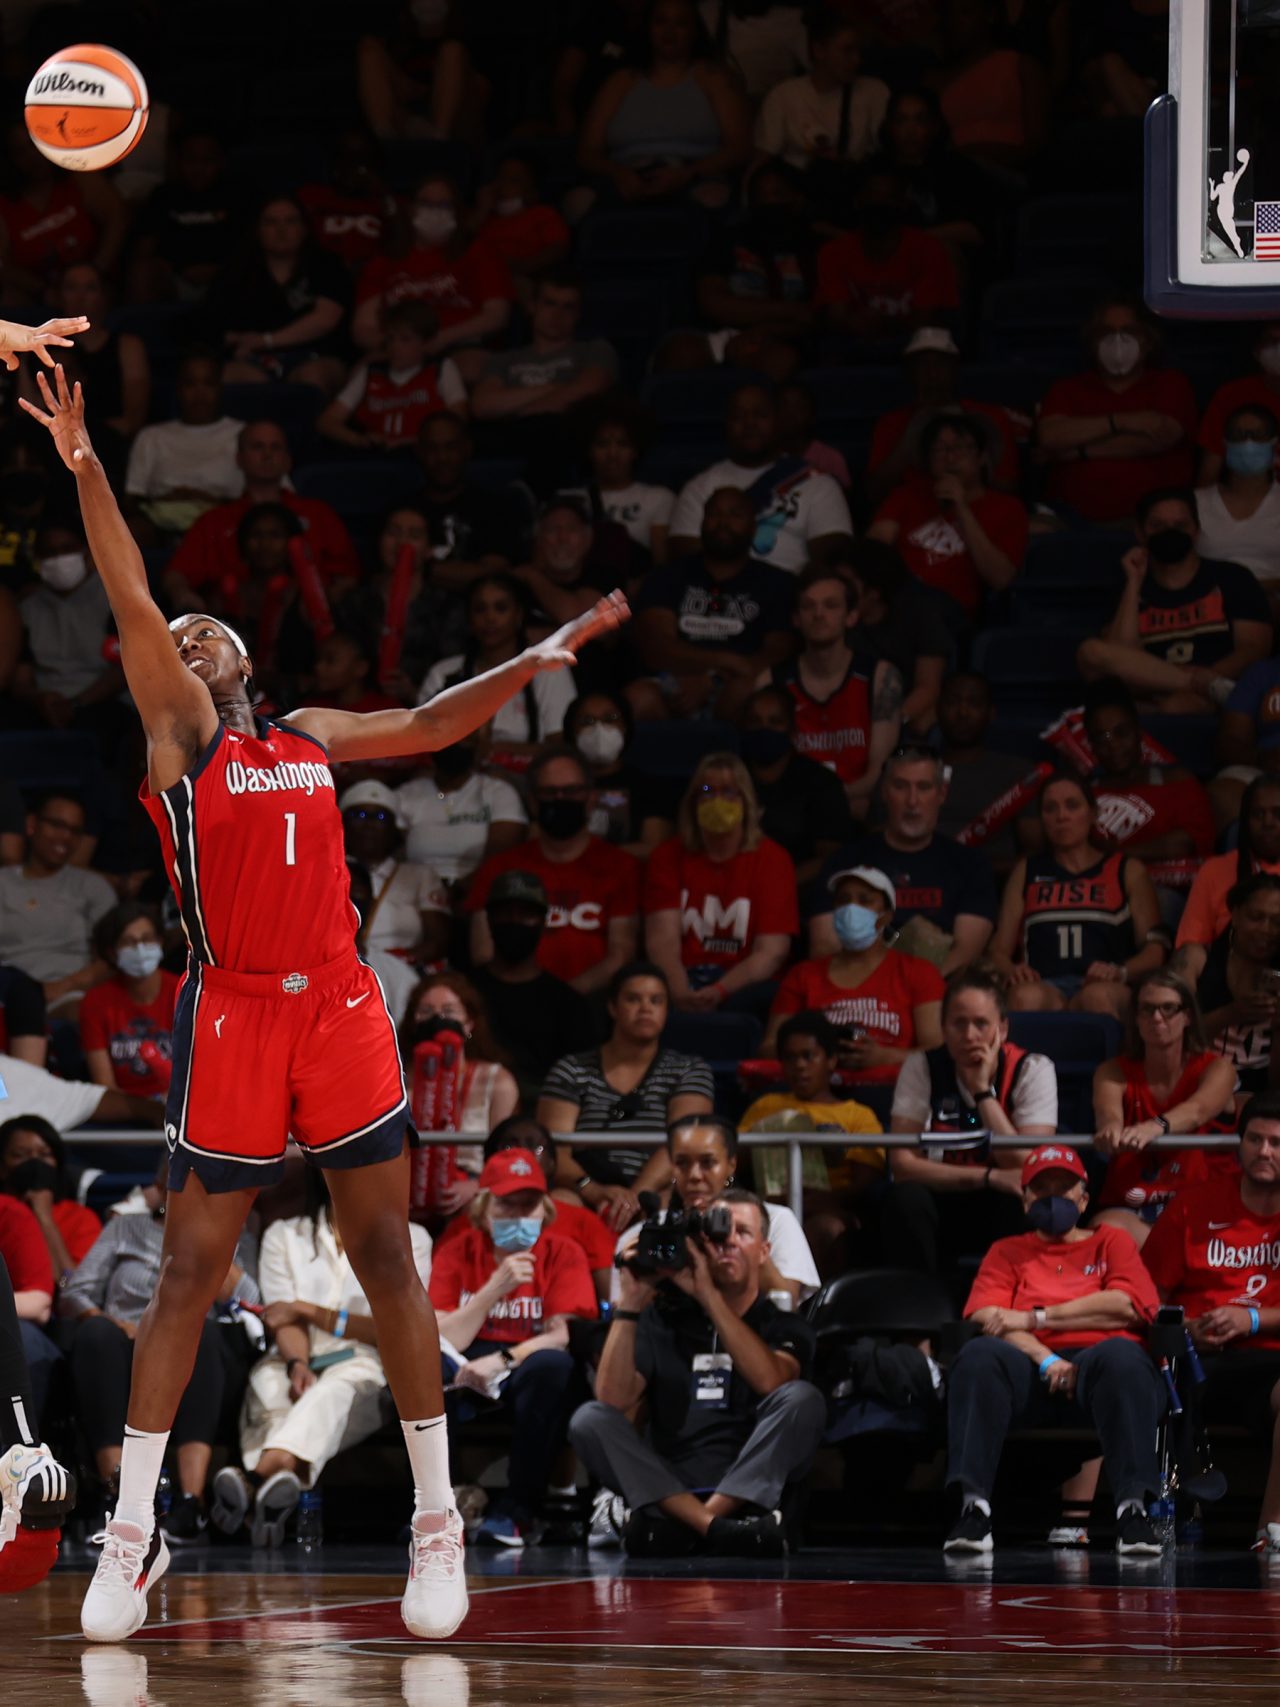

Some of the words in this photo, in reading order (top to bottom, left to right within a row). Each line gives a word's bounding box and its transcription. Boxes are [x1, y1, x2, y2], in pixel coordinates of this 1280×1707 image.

[34, 72, 105, 97] Wilson
[225, 760, 336, 796] Washington
[283, 812, 297, 867] 1
[1038, 881, 1107, 904] RISE
[1056, 923, 1083, 960] 11
